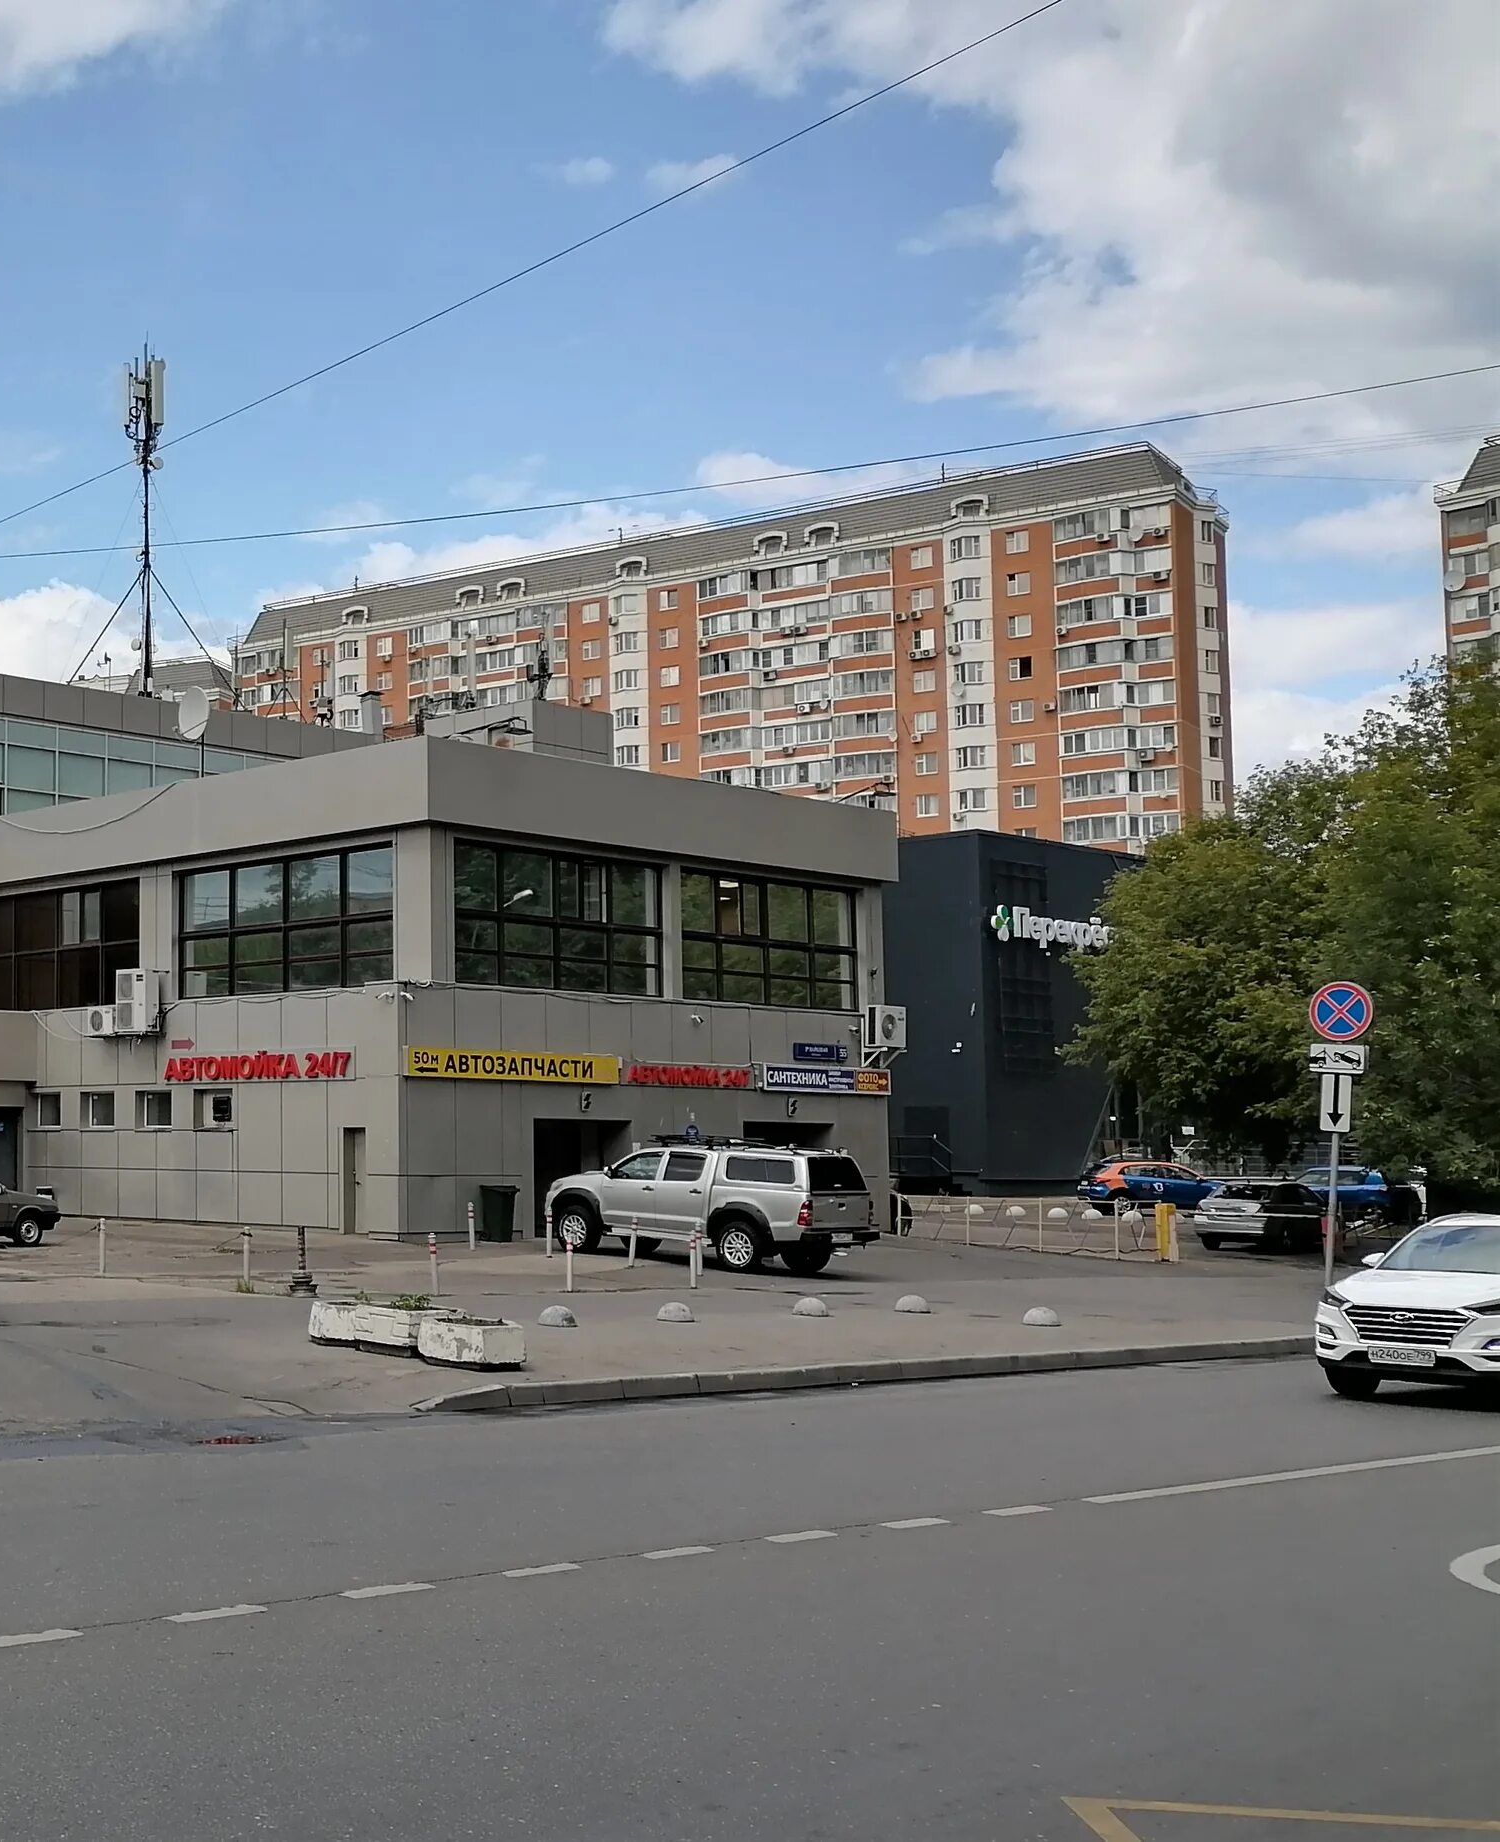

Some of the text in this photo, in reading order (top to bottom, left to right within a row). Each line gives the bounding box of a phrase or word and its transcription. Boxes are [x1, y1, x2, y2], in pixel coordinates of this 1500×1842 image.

[164, 1051, 351, 1082] АВТОМОЙКА 24/7
[444, 1054, 593, 1079] АВТОЗАПЧАСТИ
[767, 1071, 828, 1086] САНТЕХНИКА
[858, 1073, 879, 1084] ФОТО
